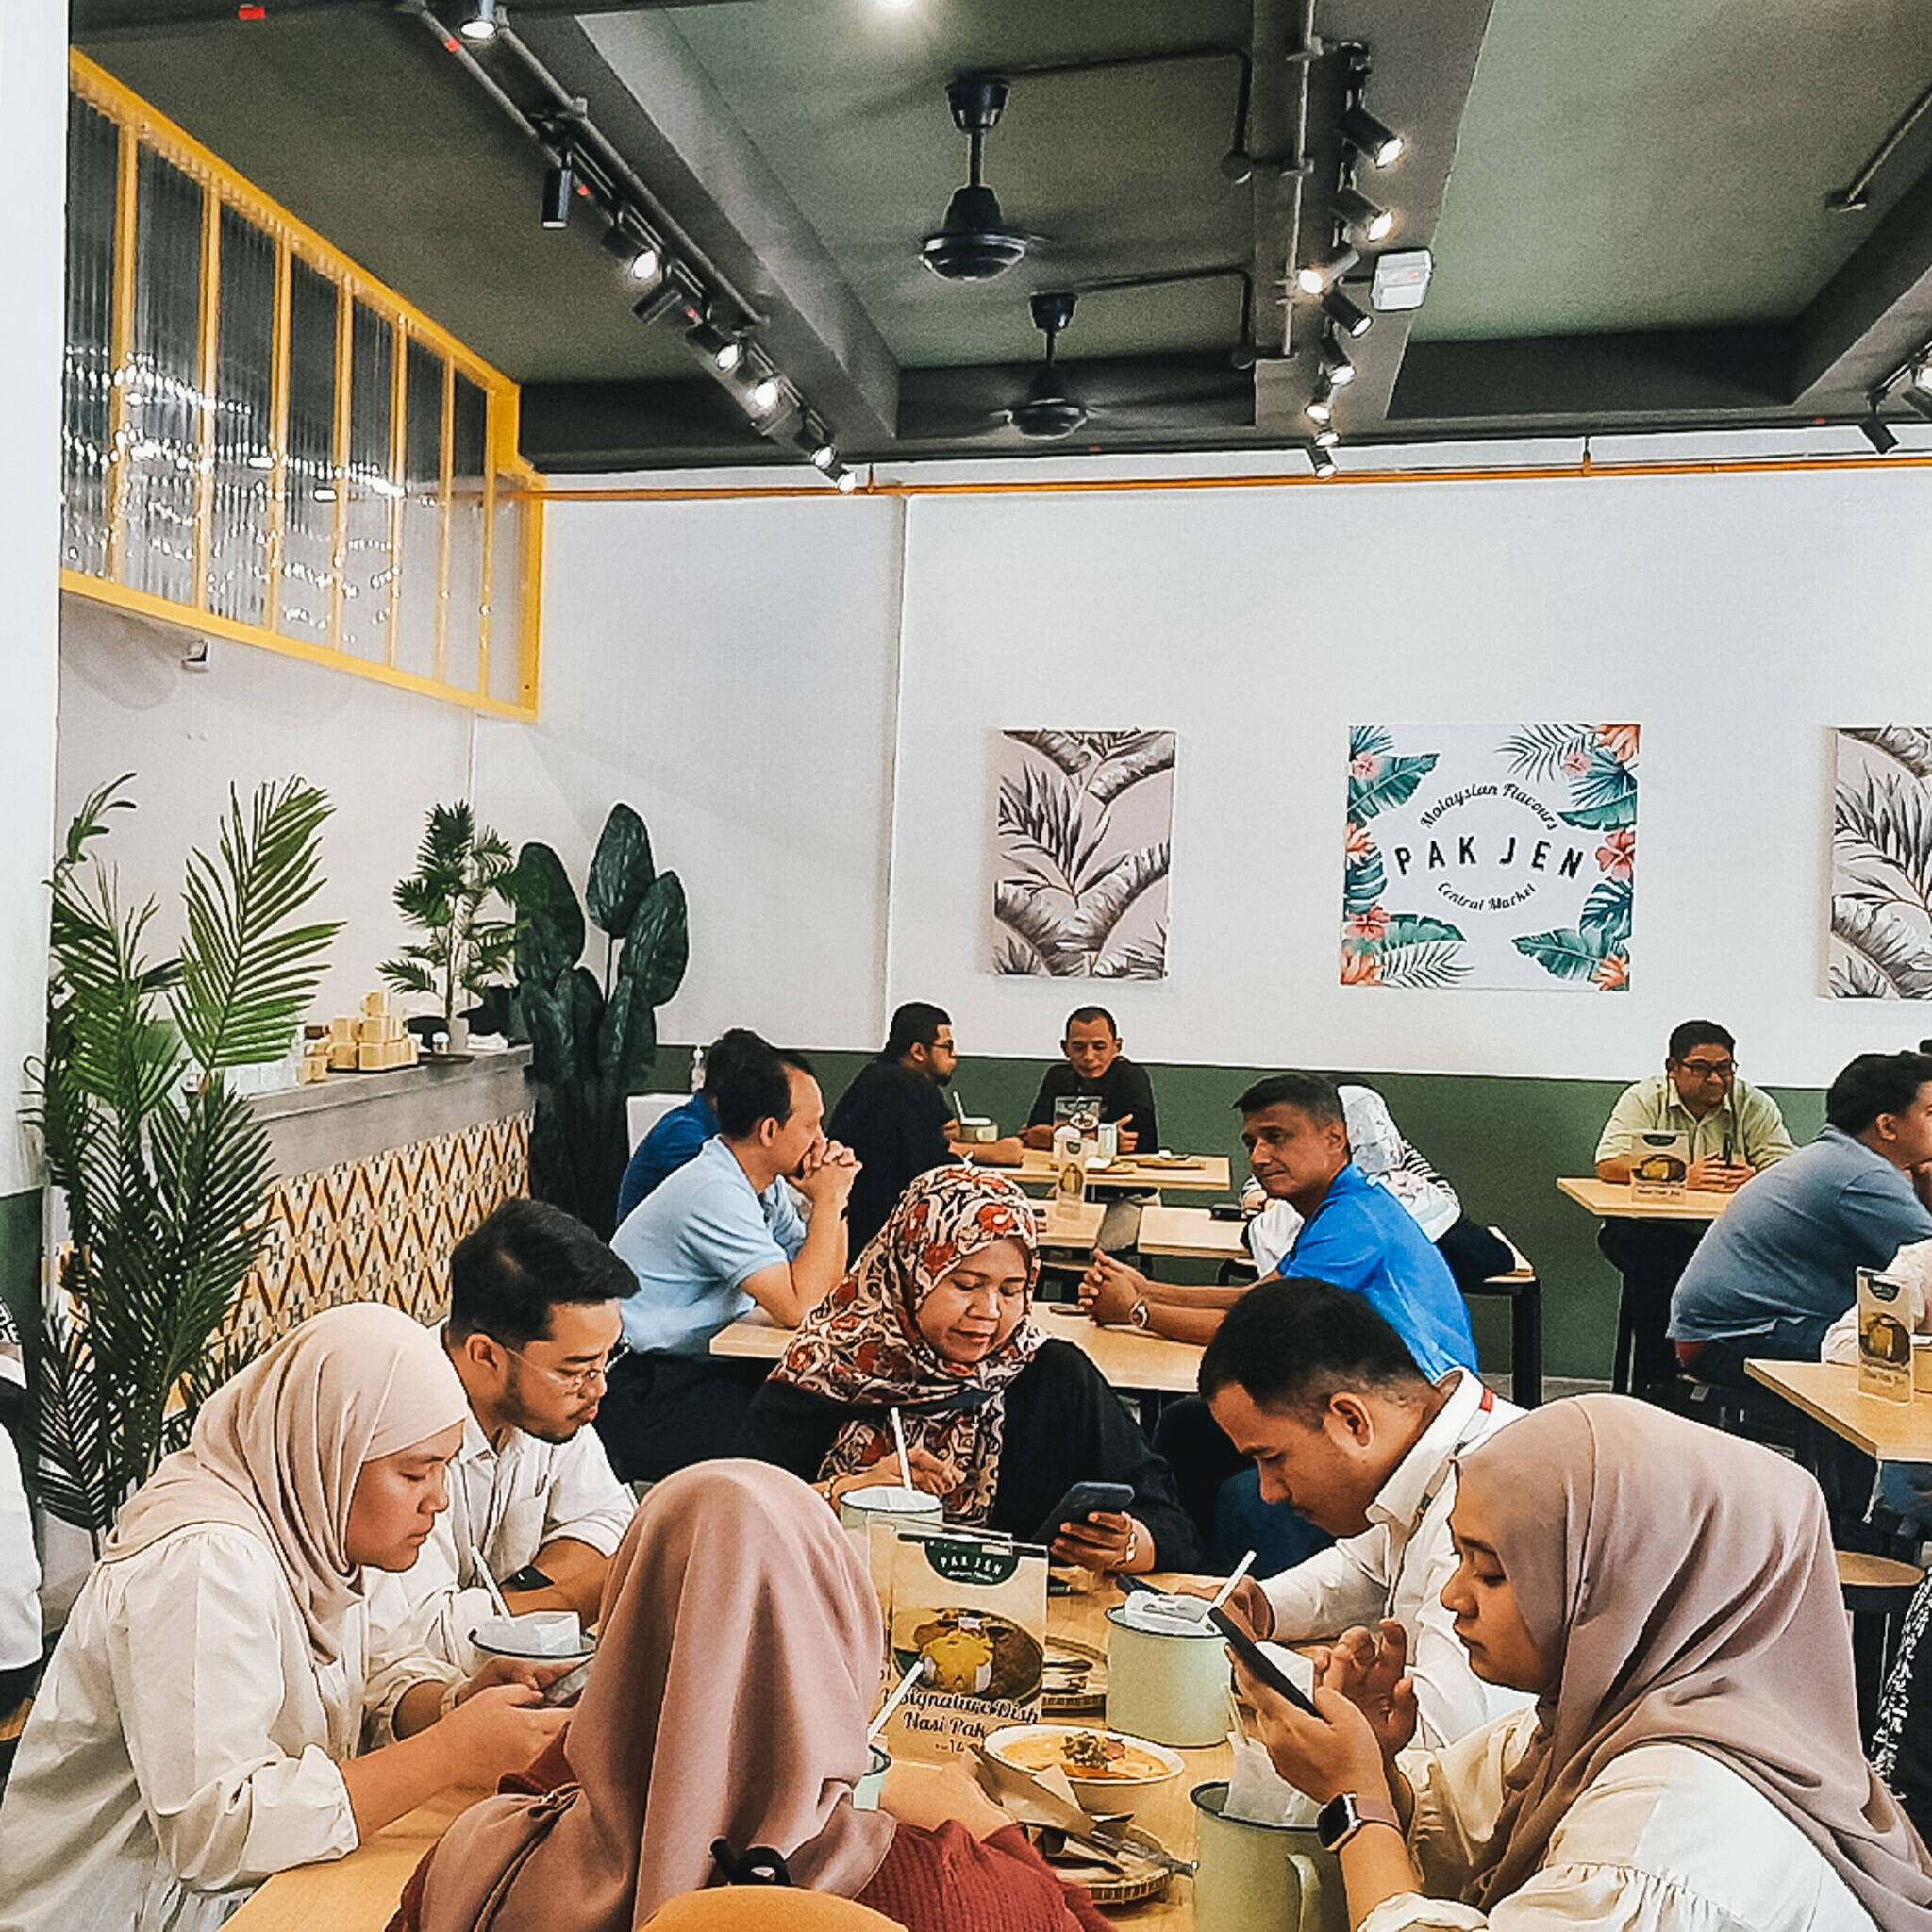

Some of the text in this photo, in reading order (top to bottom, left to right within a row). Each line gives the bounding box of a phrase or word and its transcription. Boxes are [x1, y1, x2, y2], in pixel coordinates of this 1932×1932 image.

[1420, 783, 1558, 831] Malaysian Flavours
[1394, 835, 1584, 879] PAK JEN
[1437, 882, 1537, 911] Central Market
[903, 1711, 987, 1740] Nasi Pak
[990, 1698, 1039, 1724] Dish
